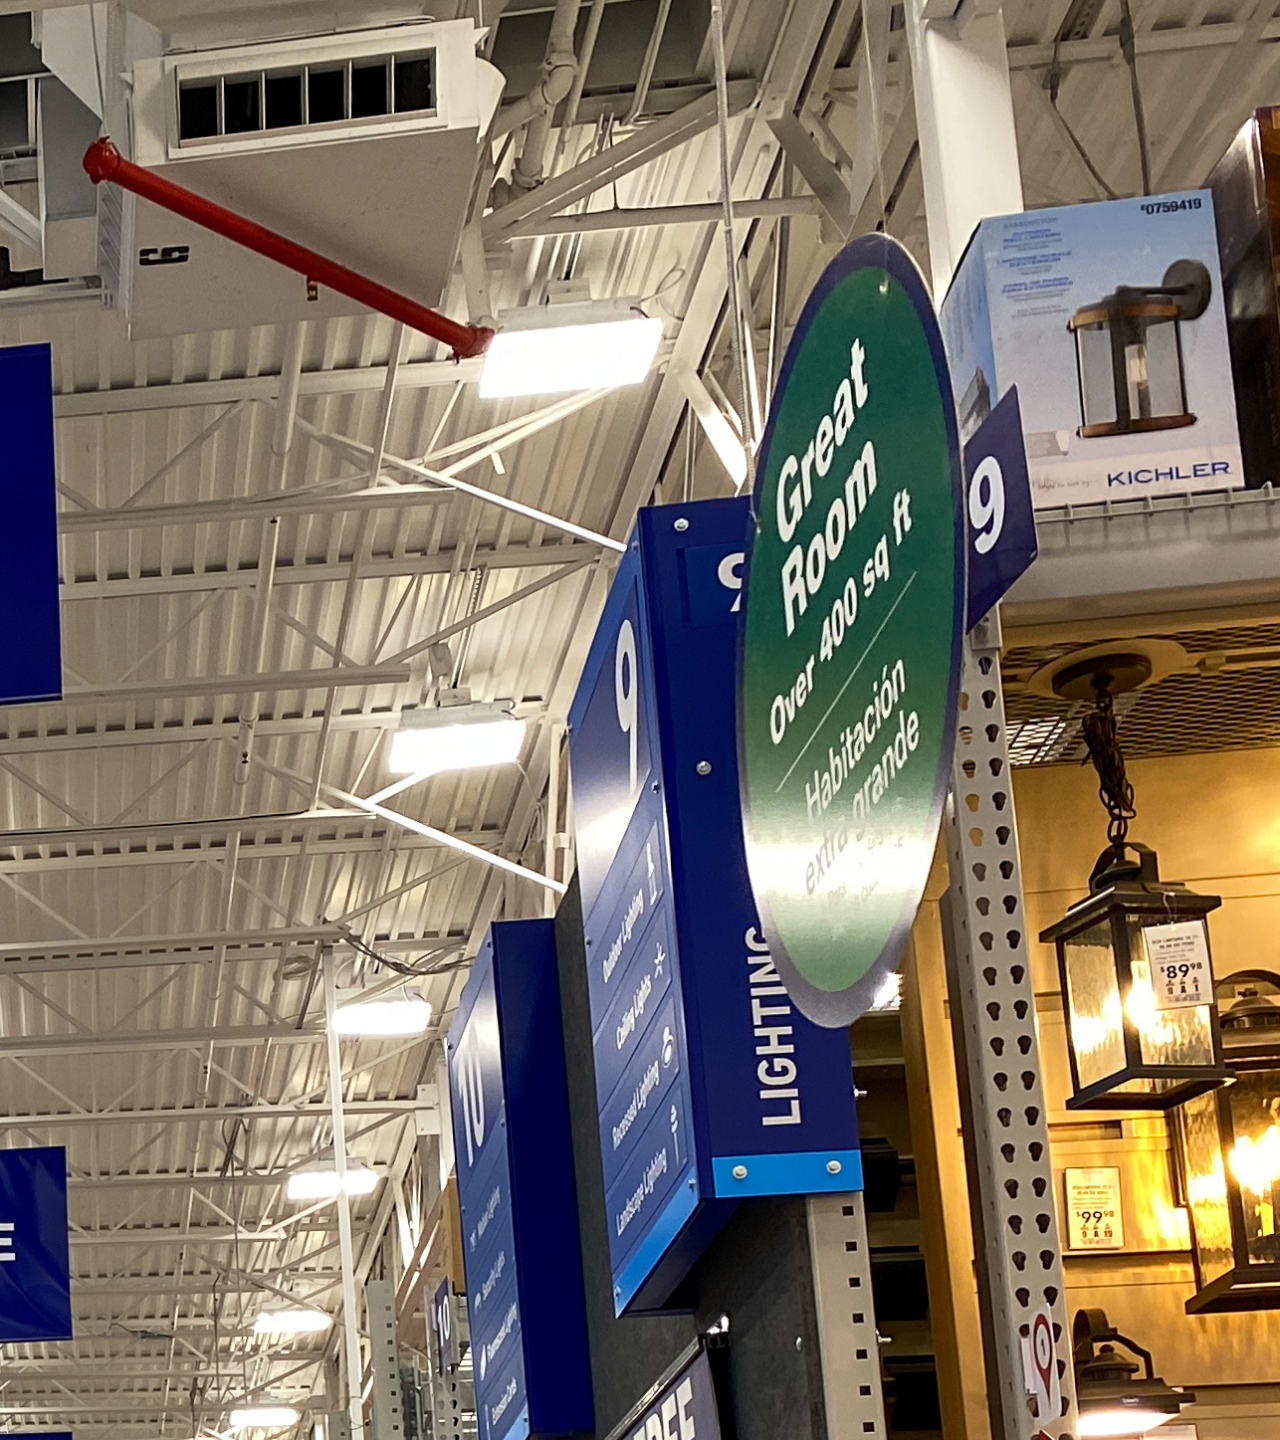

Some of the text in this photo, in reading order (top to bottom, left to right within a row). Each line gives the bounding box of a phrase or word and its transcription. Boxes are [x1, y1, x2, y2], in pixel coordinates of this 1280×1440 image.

[776, 337, 868, 542] Great
[1107, 461, 1231, 487] KICHLER
[781, 440, 878, 637] Room
[968, 455, 1006, 555] 9
[769, 487, 912, 745] Over 400 sq ft
[615, 619, 639, 797] 9
[804, 657, 907, 824] Habitación
[852, 709, 919, 830] grande
[621, 889, 644, 943] Lighting
[616, 974, 652, 1051] Ceiling Lights
[457, 1032, 486, 1168] 10
[612, 1060, 660, 1151] Recessed Lighting
[615, 1147, 667, 1237] Landscape Lighting
